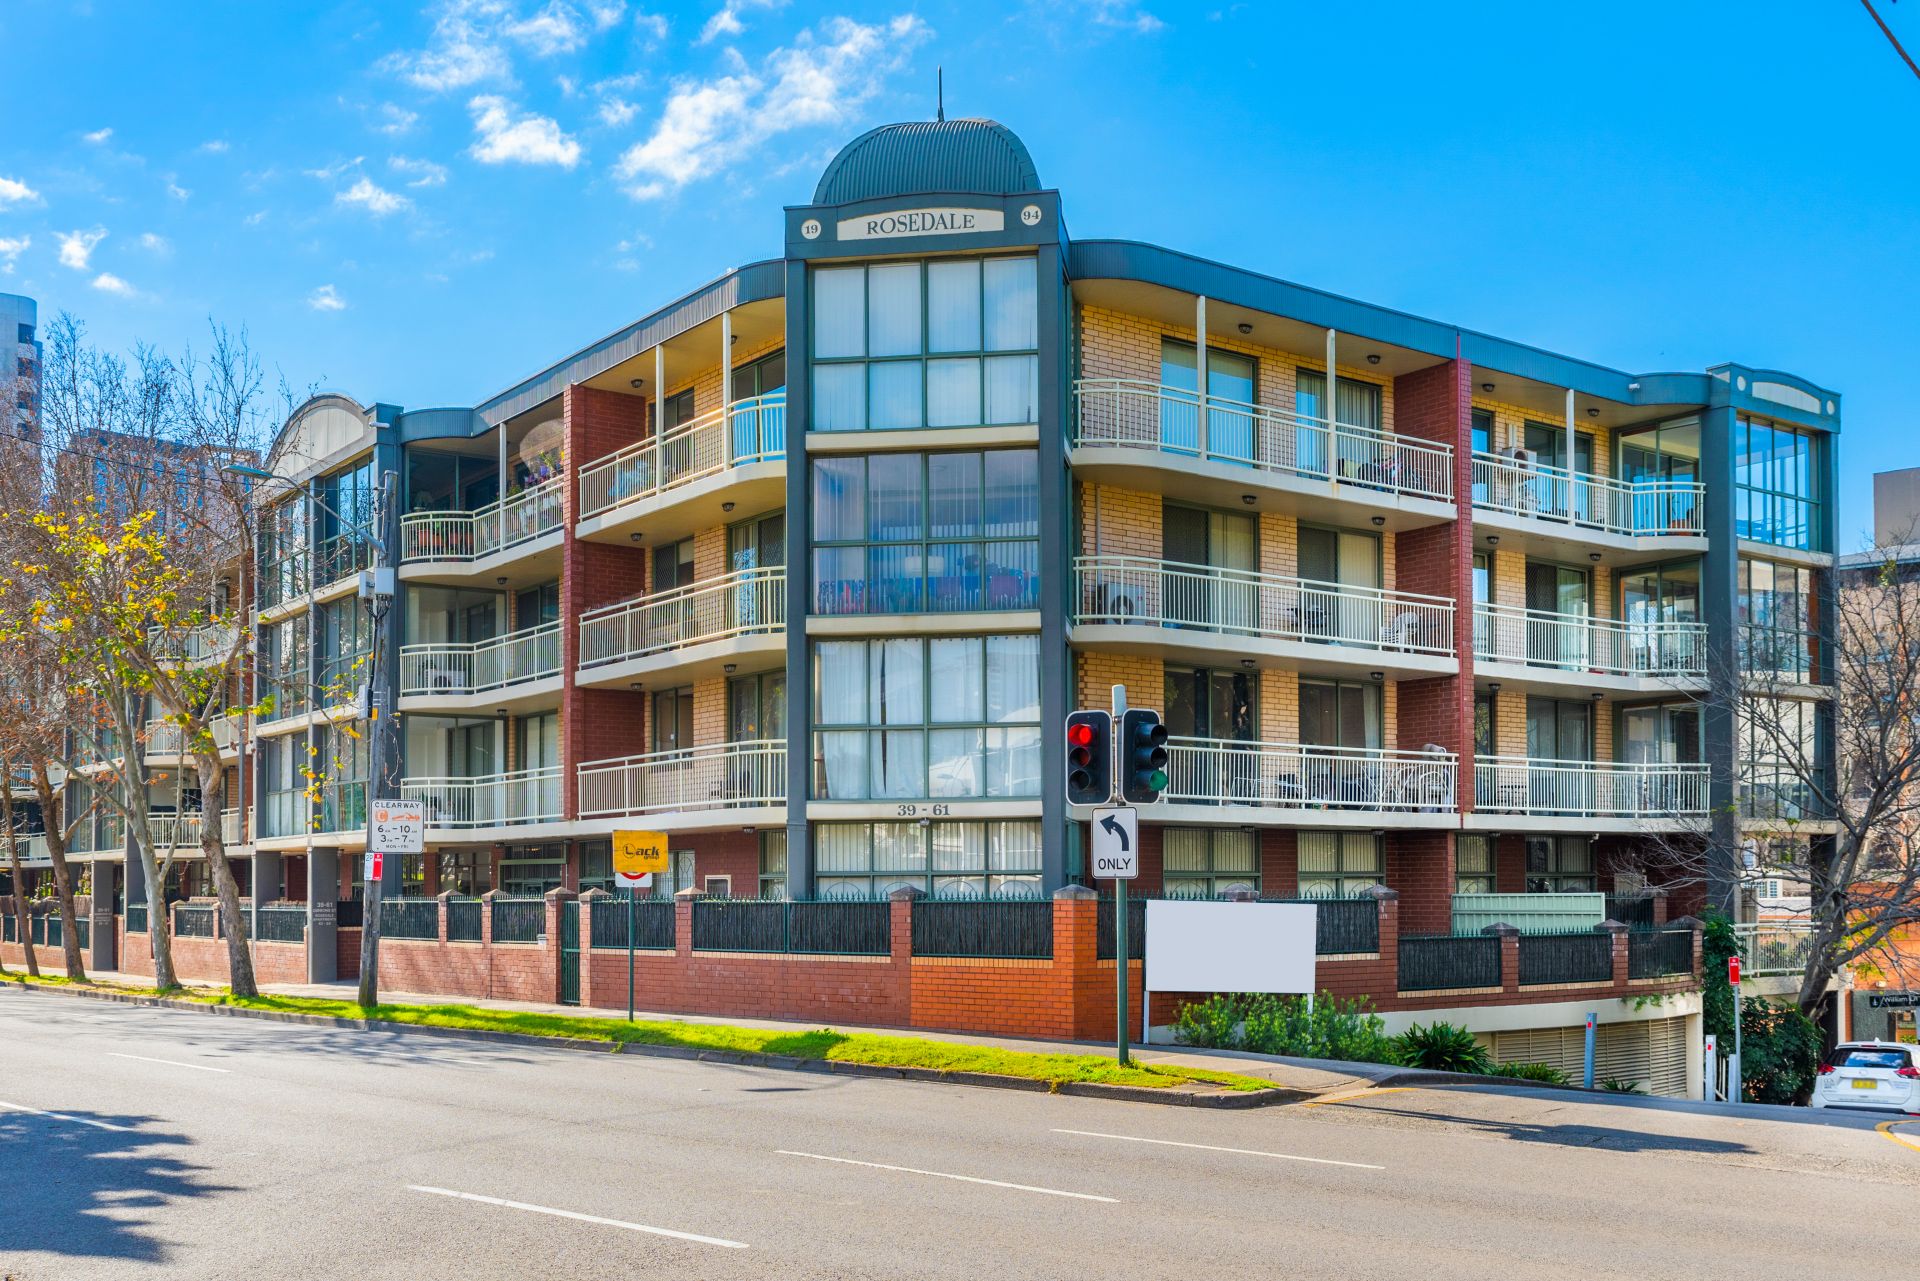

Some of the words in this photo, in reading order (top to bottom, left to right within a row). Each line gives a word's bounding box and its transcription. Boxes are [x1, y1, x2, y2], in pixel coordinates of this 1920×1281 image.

[1023, 210, 1040, 221] 94
[866, 211, 976, 236] ROSEDALE
[803, 224, 818, 235] 19
[374, 801, 420, 809] CLEARWAY
[897, 804, 917, 817] 39
[932, 804, 951, 816] 61
[377, 824, 384, 833] 6
[400, 824, 411, 834] 10
[380, 834, 387, 843] 3
[401, 834, 408, 843] 7
[624, 845, 660, 856] Lack
[1098, 858, 1131, 870] ONLY
